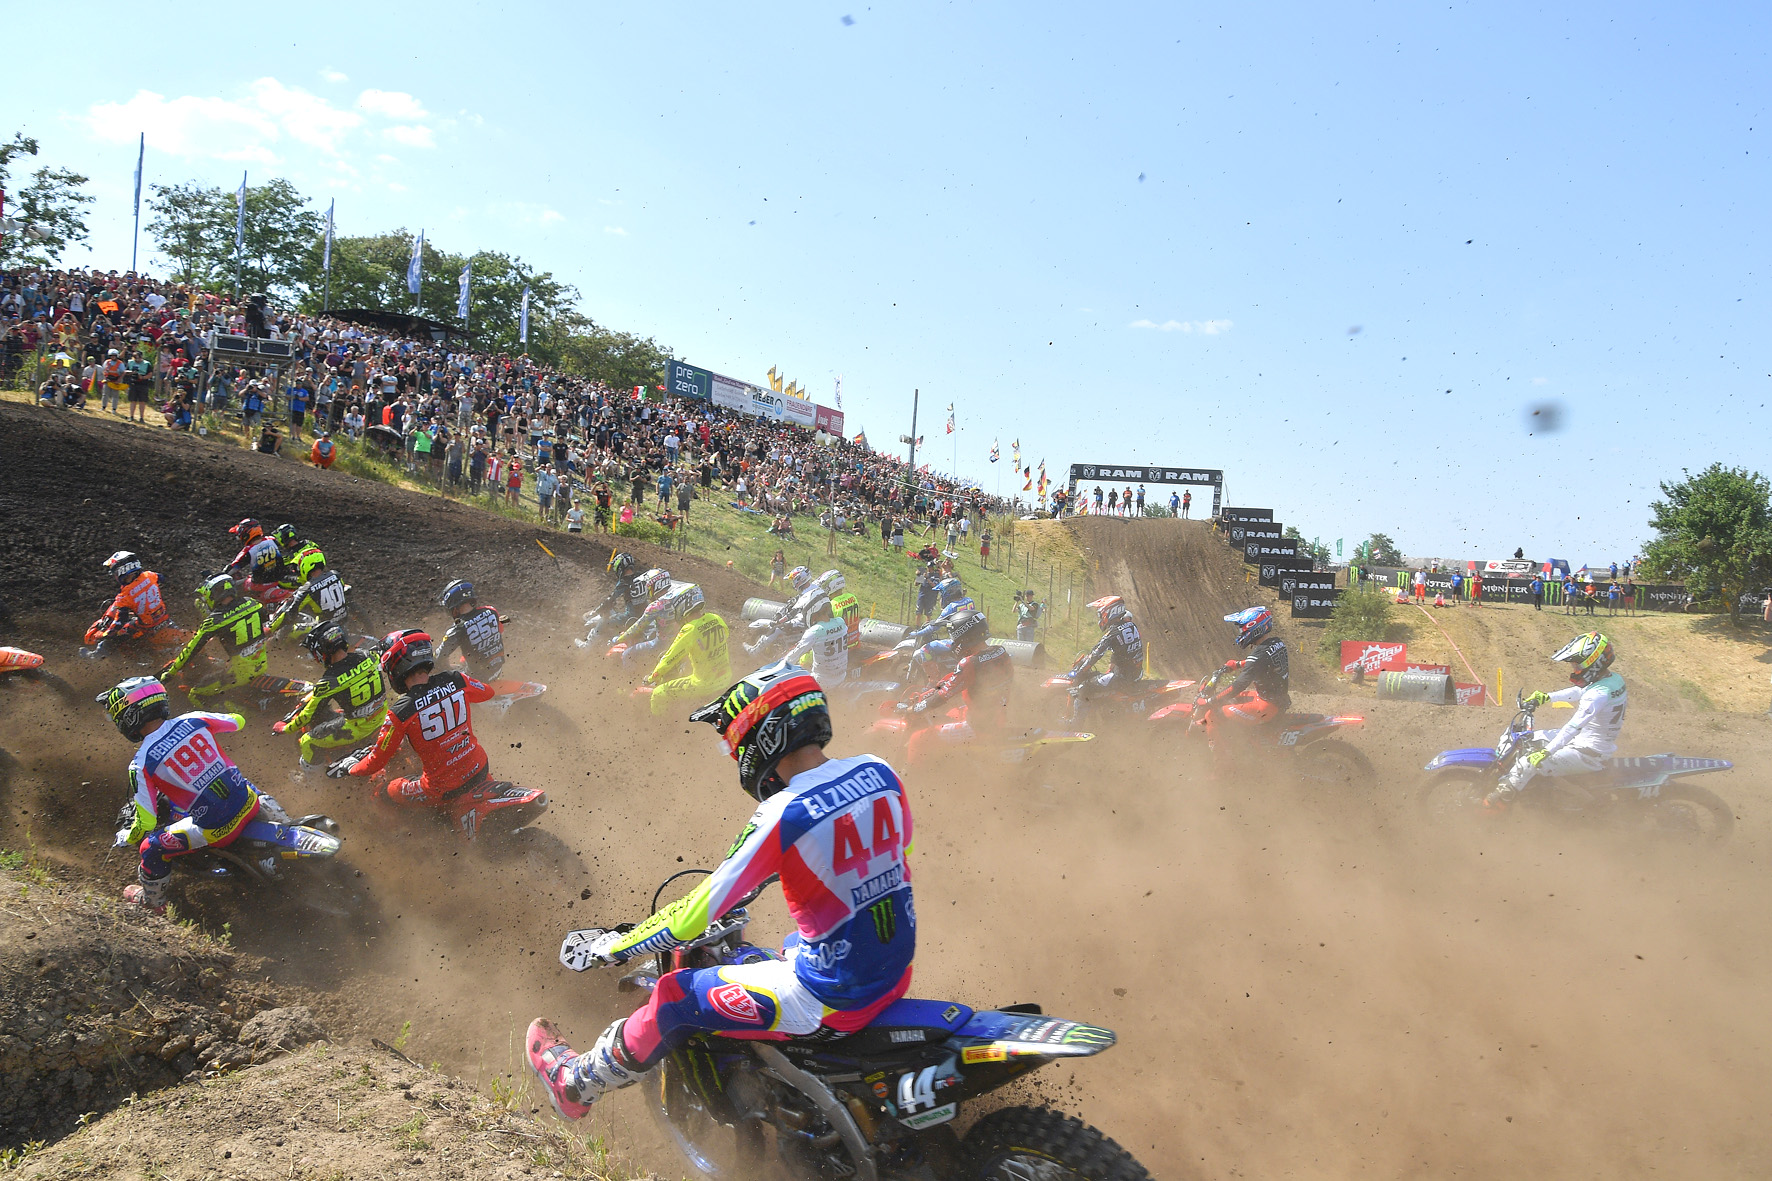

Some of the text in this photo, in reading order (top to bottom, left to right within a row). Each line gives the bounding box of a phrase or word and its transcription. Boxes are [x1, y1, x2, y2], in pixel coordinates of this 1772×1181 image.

[676, 366, 693, 379] pre
[676, 380, 698, 395] zero
[1099, 469, 1210, 481] RAM RAM
[1246, 531, 1279, 539] RAM
[256, 546, 277, 566] 579
[1260, 547, 1294, 555] RAM
[134, 584, 161, 615] 79
[320, 580, 346, 612] 401
[229, 611, 262, 646] 11
[463, 609, 492, 628] PANCAR
[466, 614, 499, 645] 253
[477, 632, 501, 651] UFO
[702, 624, 725, 651] 770
[1121, 625, 1140, 645] 64
[337, 657, 374, 685] OLIVER
[349, 669, 382, 707] 51
[415, 681, 457, 710] GIFTING
[418, 689, 468, 741] 517
[148, 719, 195, 761] BENISTANT
[163, 733, 219, 785] 198
[446, 743, 476, 766] GASGAS
[193, 762, 224, 790] YAMAHA
[801, 766, 887, 820] ELZINGA
[832, 796, 901, 880] 44
[889, 1029, 927, 1043] YAMAHA
[965, 1047, 1003, 1061] PIRELLI
[897, 1064, 938, 1114] 44
